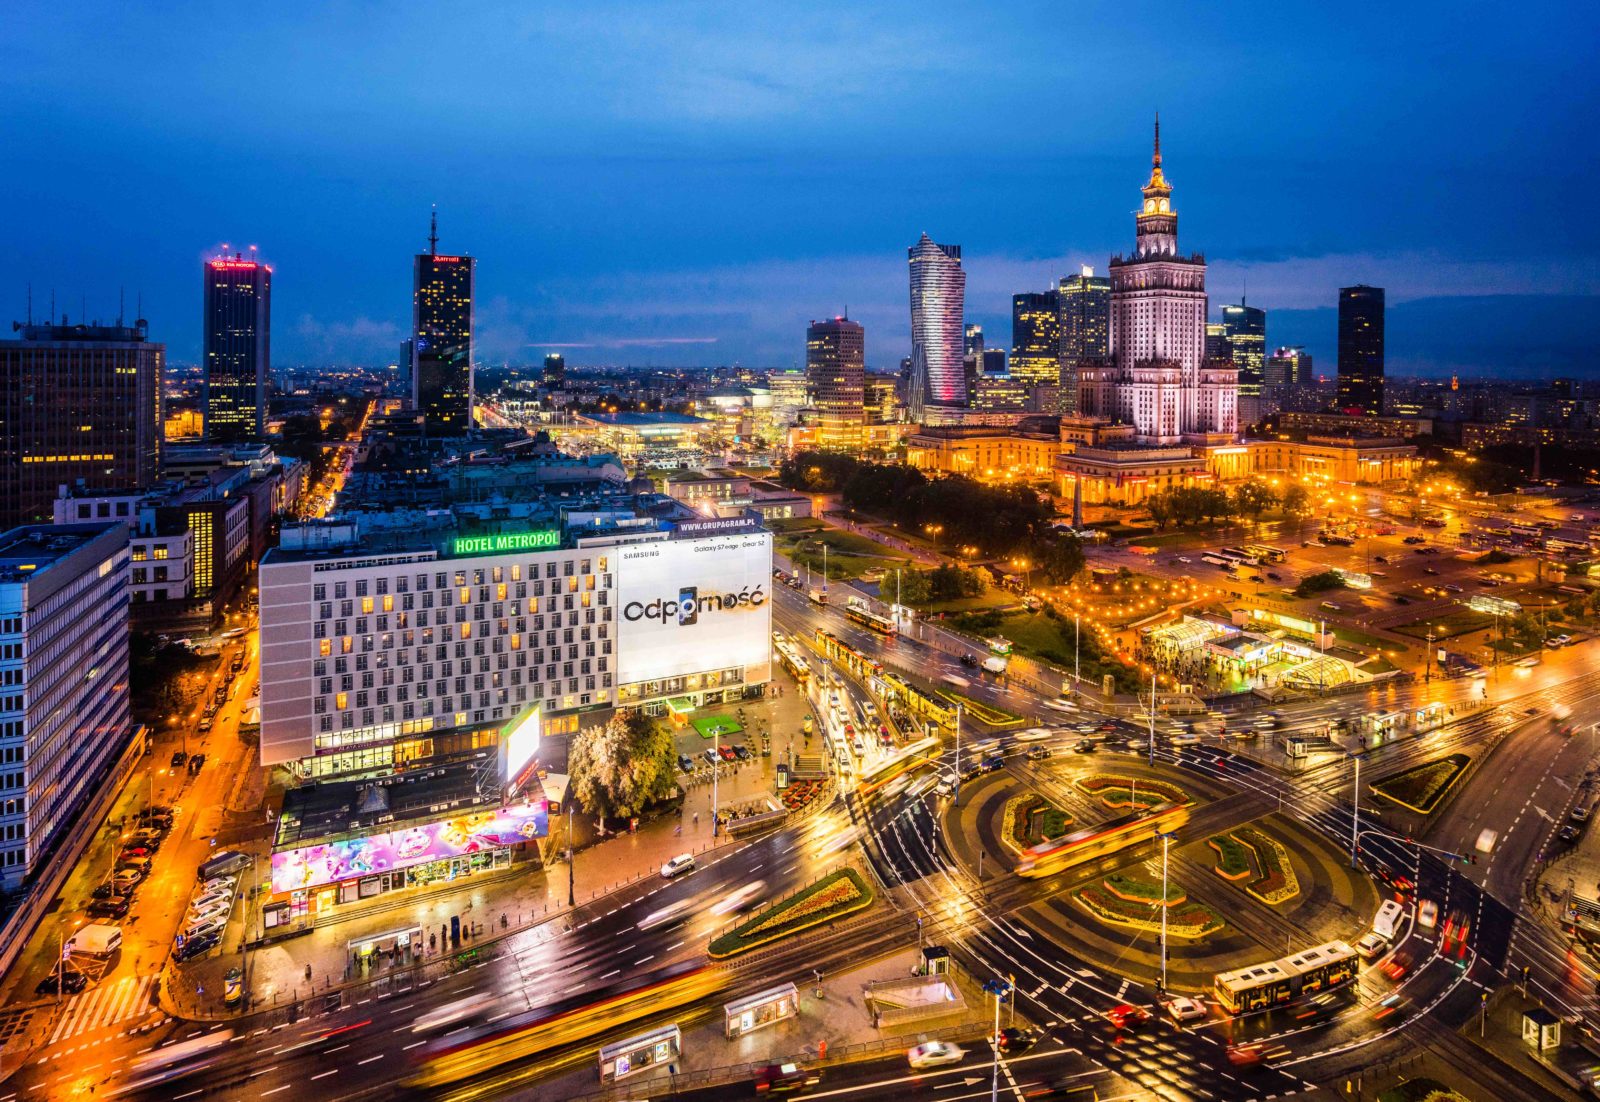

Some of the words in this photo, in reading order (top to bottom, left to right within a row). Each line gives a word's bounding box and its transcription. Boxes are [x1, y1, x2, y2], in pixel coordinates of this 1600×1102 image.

[680, 518, 755, 531] WWW.GRUPAGRAM.PL
[456, 538, 494, 553] HOTEL
[496, 533, 558, 549] METROPOL
[623, 551, 660, 559] SAMSUNG
